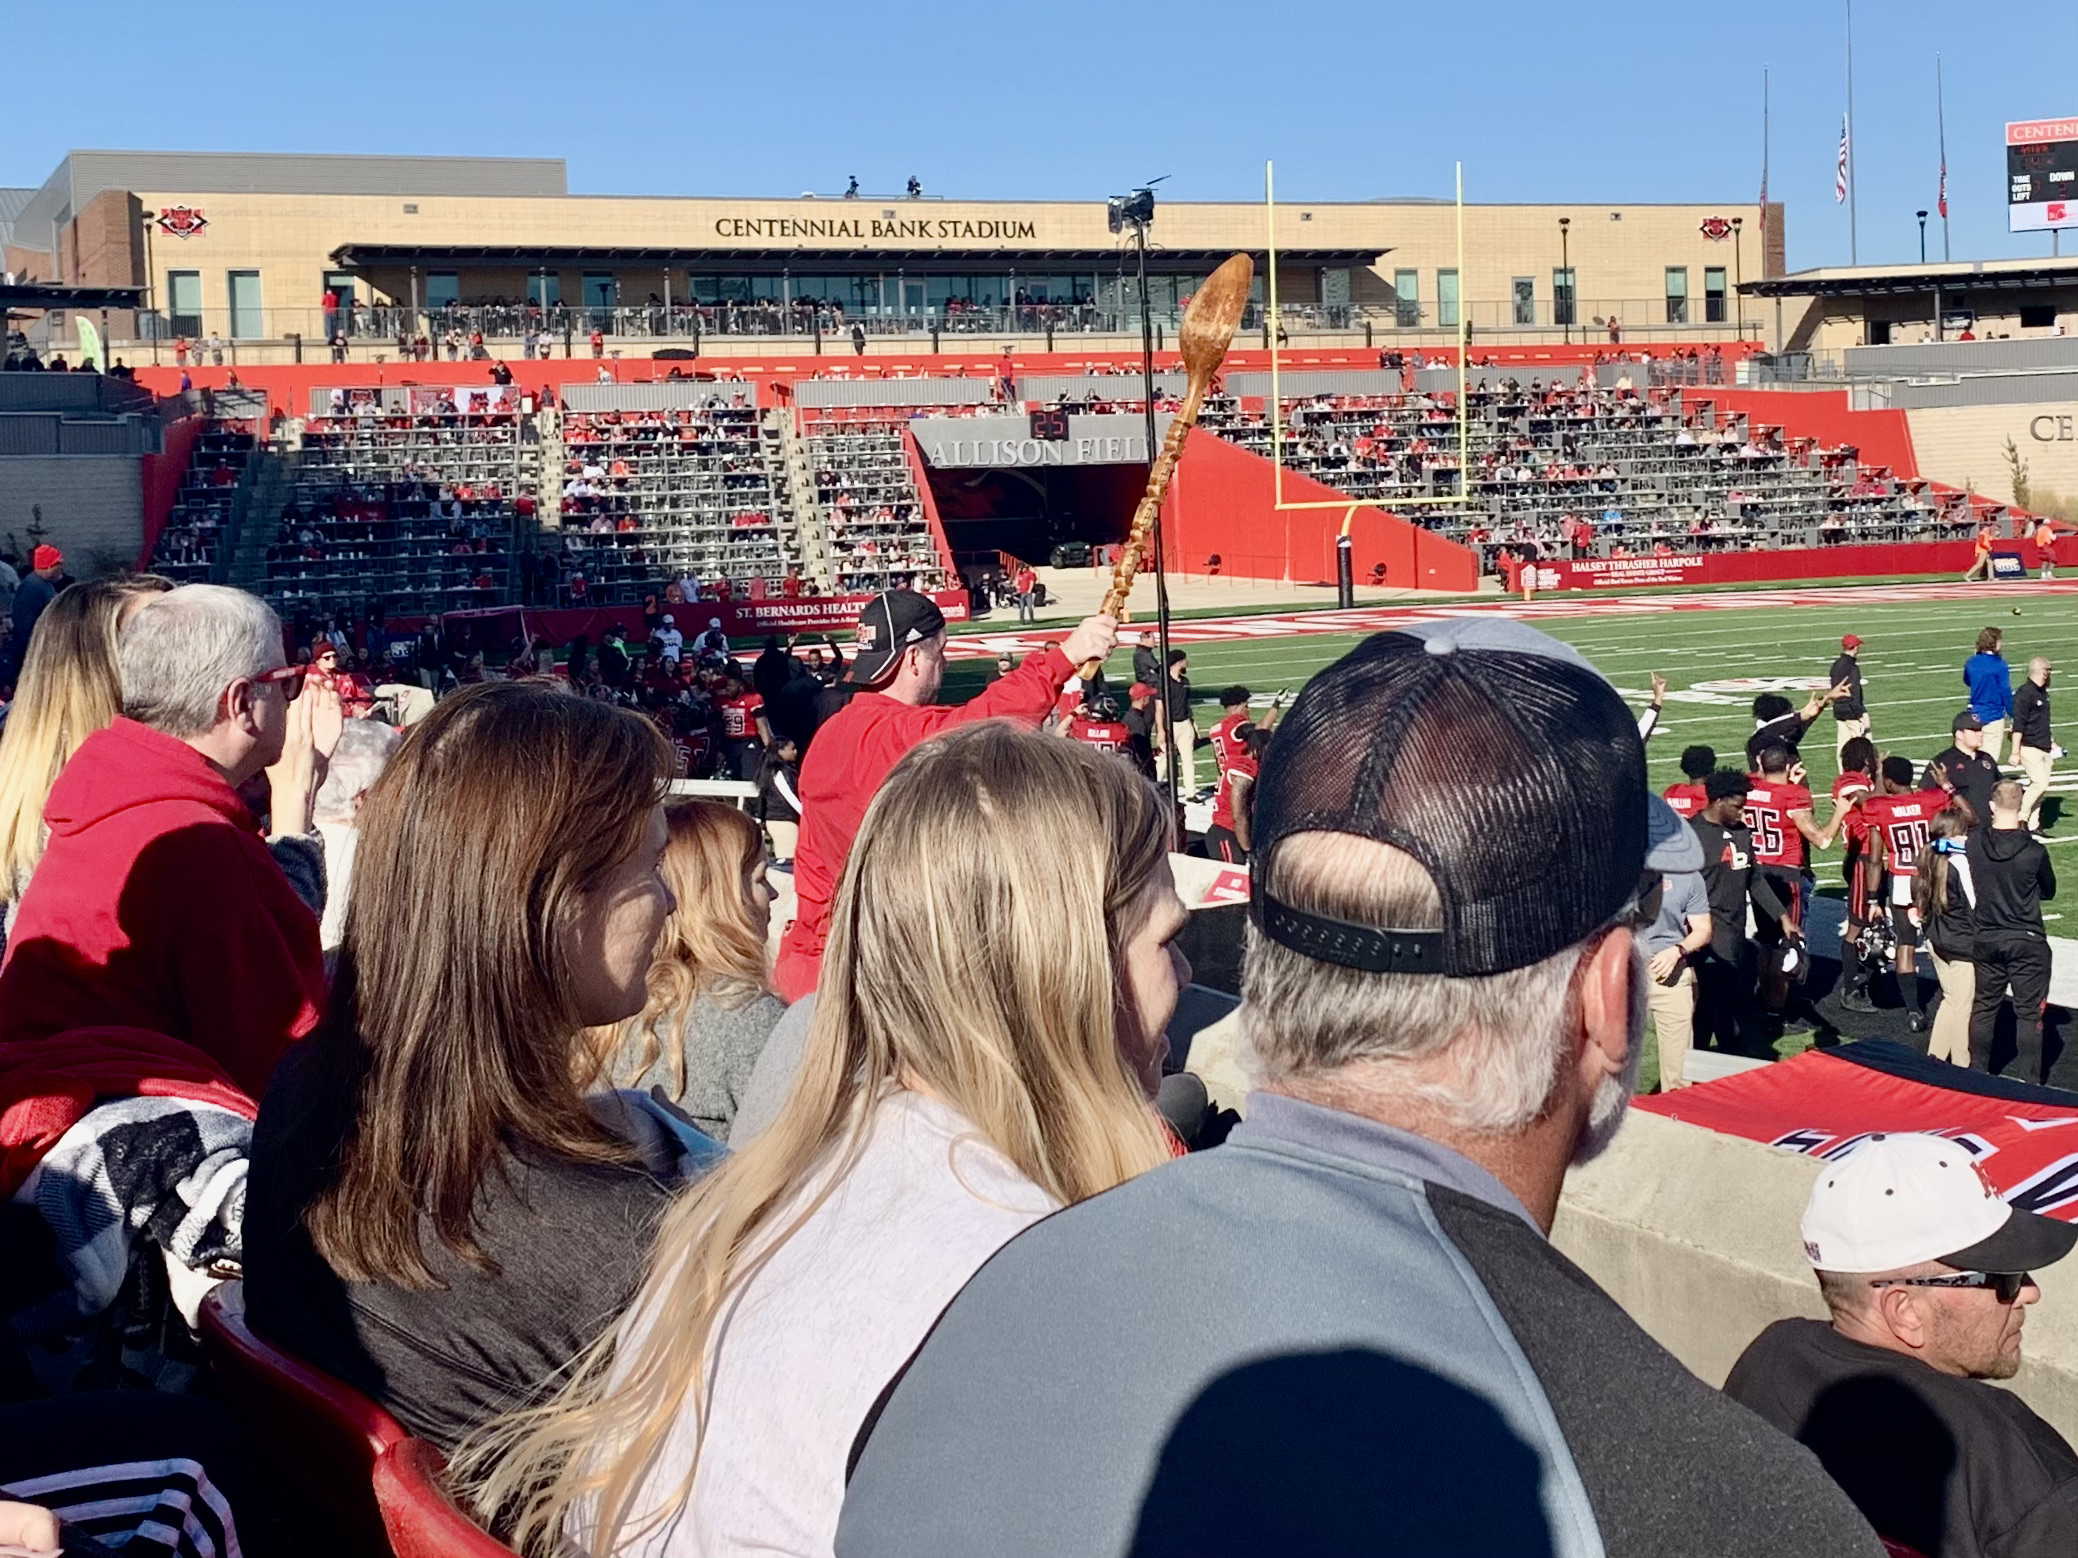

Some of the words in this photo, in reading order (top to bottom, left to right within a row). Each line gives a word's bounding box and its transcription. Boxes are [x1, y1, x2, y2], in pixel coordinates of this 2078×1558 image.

[2013, 174, 2031, 184] TIME
[2049, 170, 2075, 182] DOWN
[2011, 183, 2032, 193] OUTS
[2012, 192, 2031, 201] LEFT
[715, 218, 865, 238] CENTENNIAL
[871, 219, 933, 238] BANK
[938, 220, 1037, 239] STADIUM
[1034, 412, 1065, 435] 25
[930, 438, 1063, 466] ALLISON
[1571, 562, 1608, 573] HALSEY
[1608, 559, 1658, 571] THRASHER
[1659, 556, 1704, 569] HARPOLE
[735, 607, 753, 619] ST.
[755, 605, 821, 618] BERNARDS
